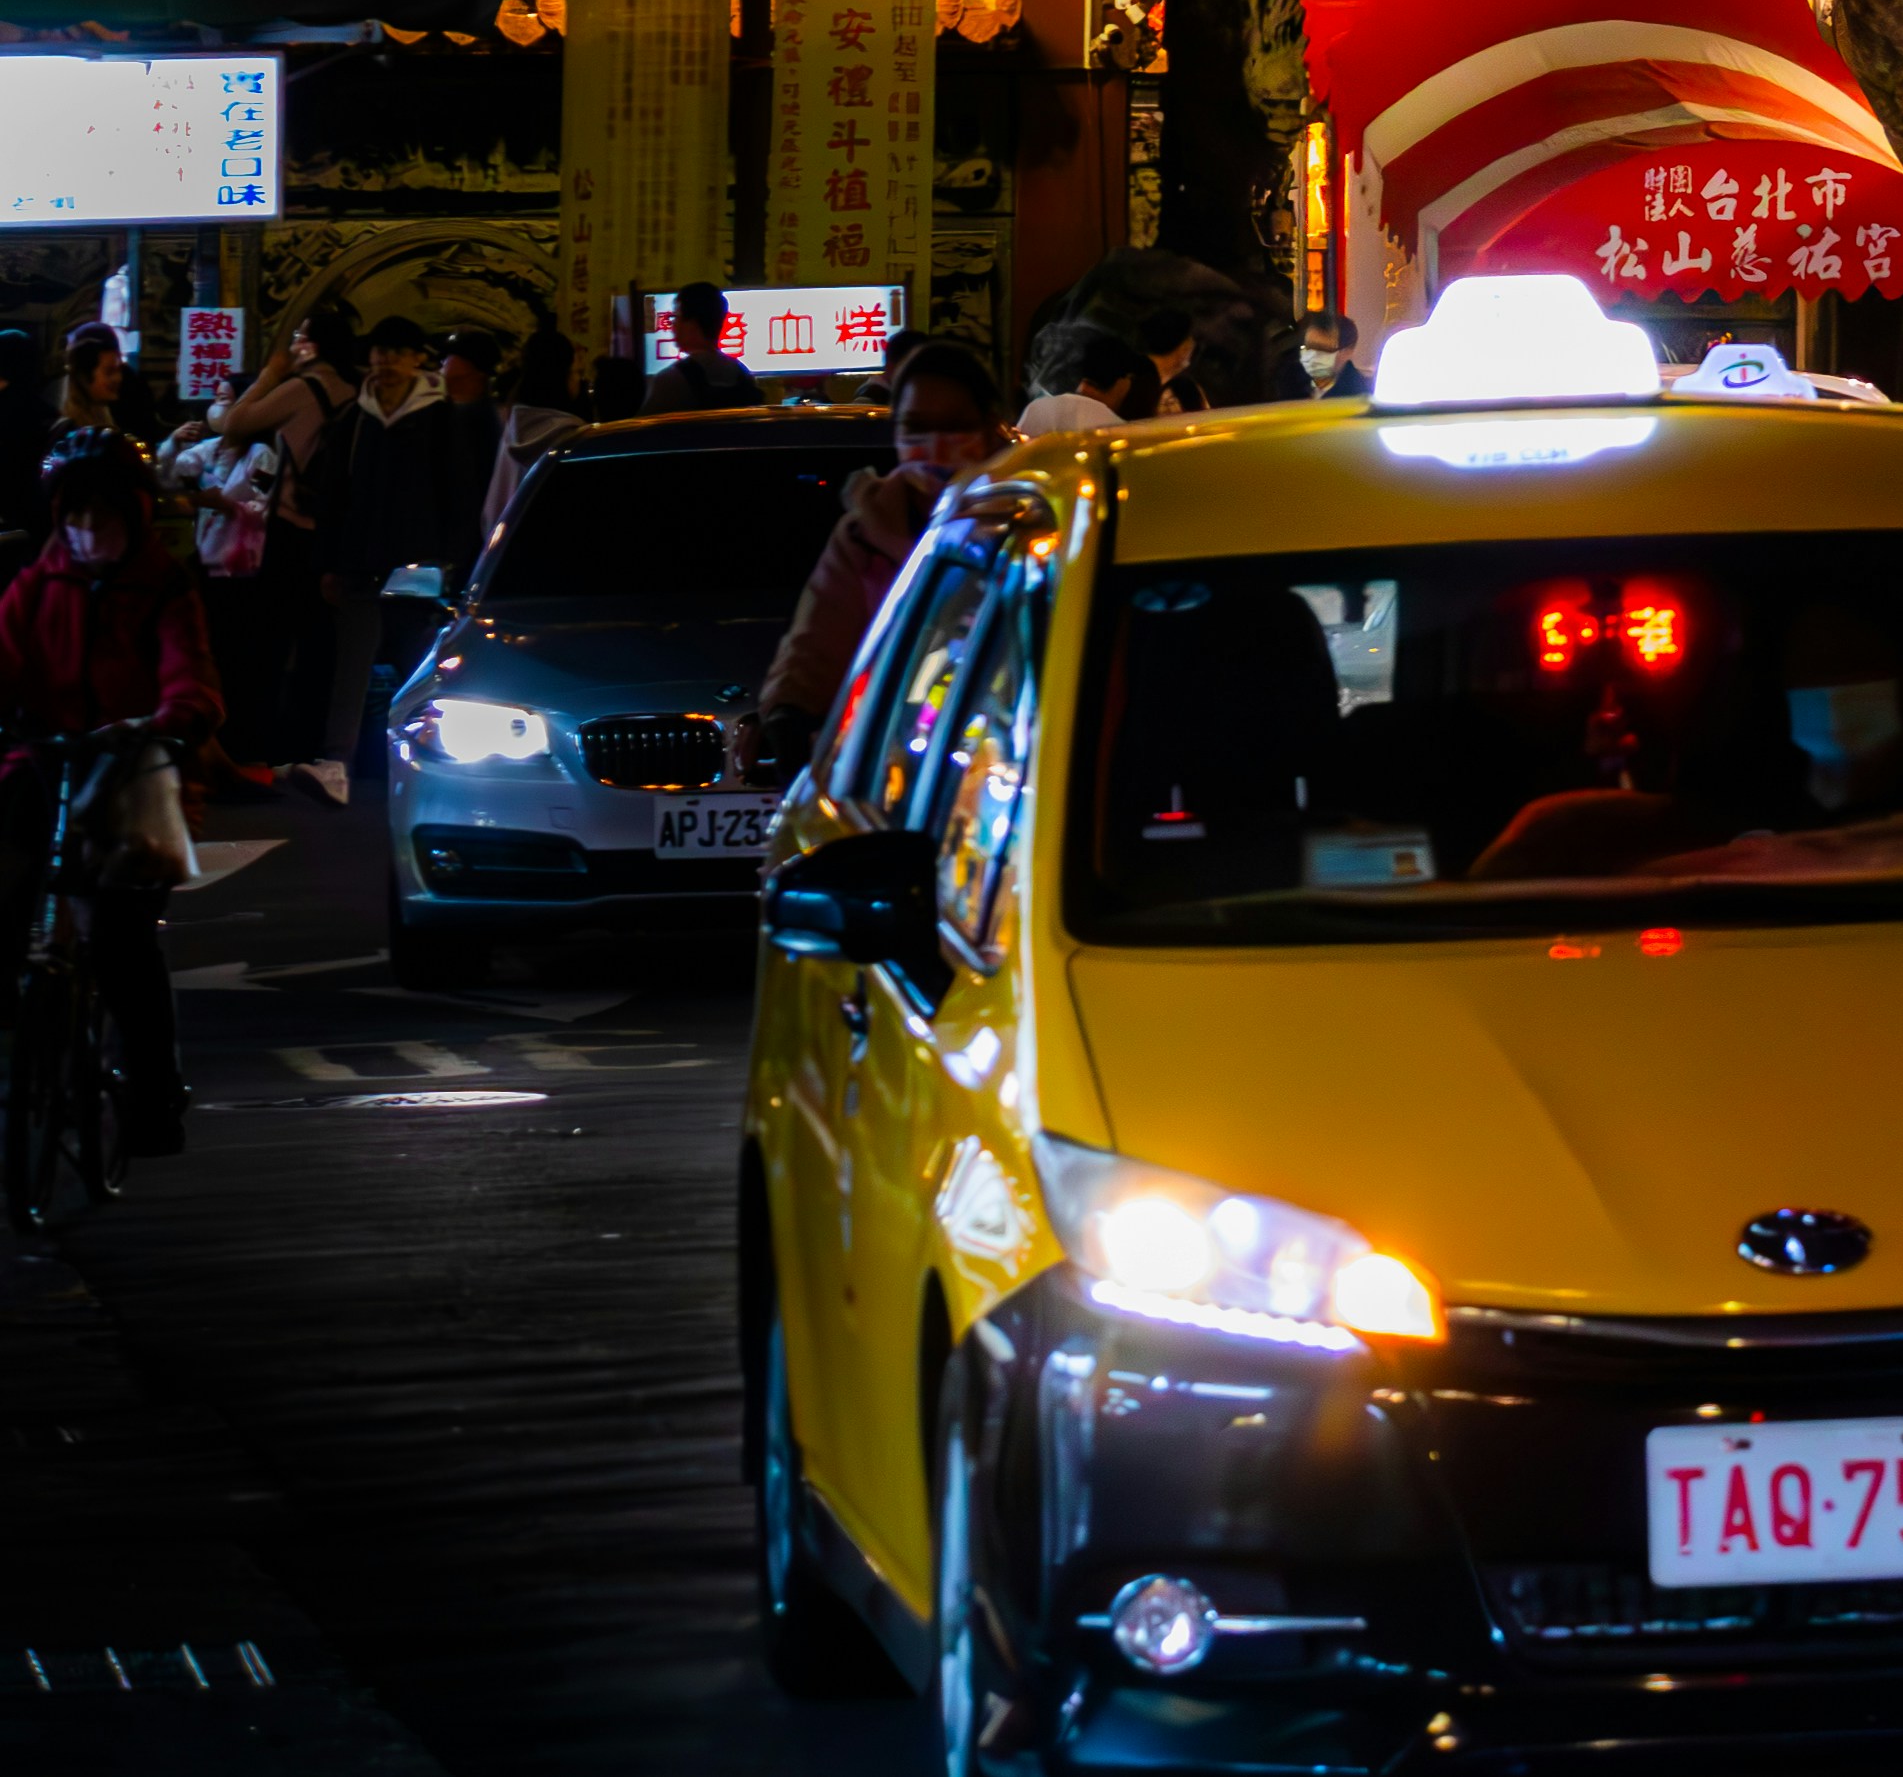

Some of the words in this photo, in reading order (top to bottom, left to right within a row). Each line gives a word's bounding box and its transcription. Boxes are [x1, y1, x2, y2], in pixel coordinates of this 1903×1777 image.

[1700, 166, 1853, 222] 台北市
[1595, 223, 1901, 283] 松山慈祐宮
